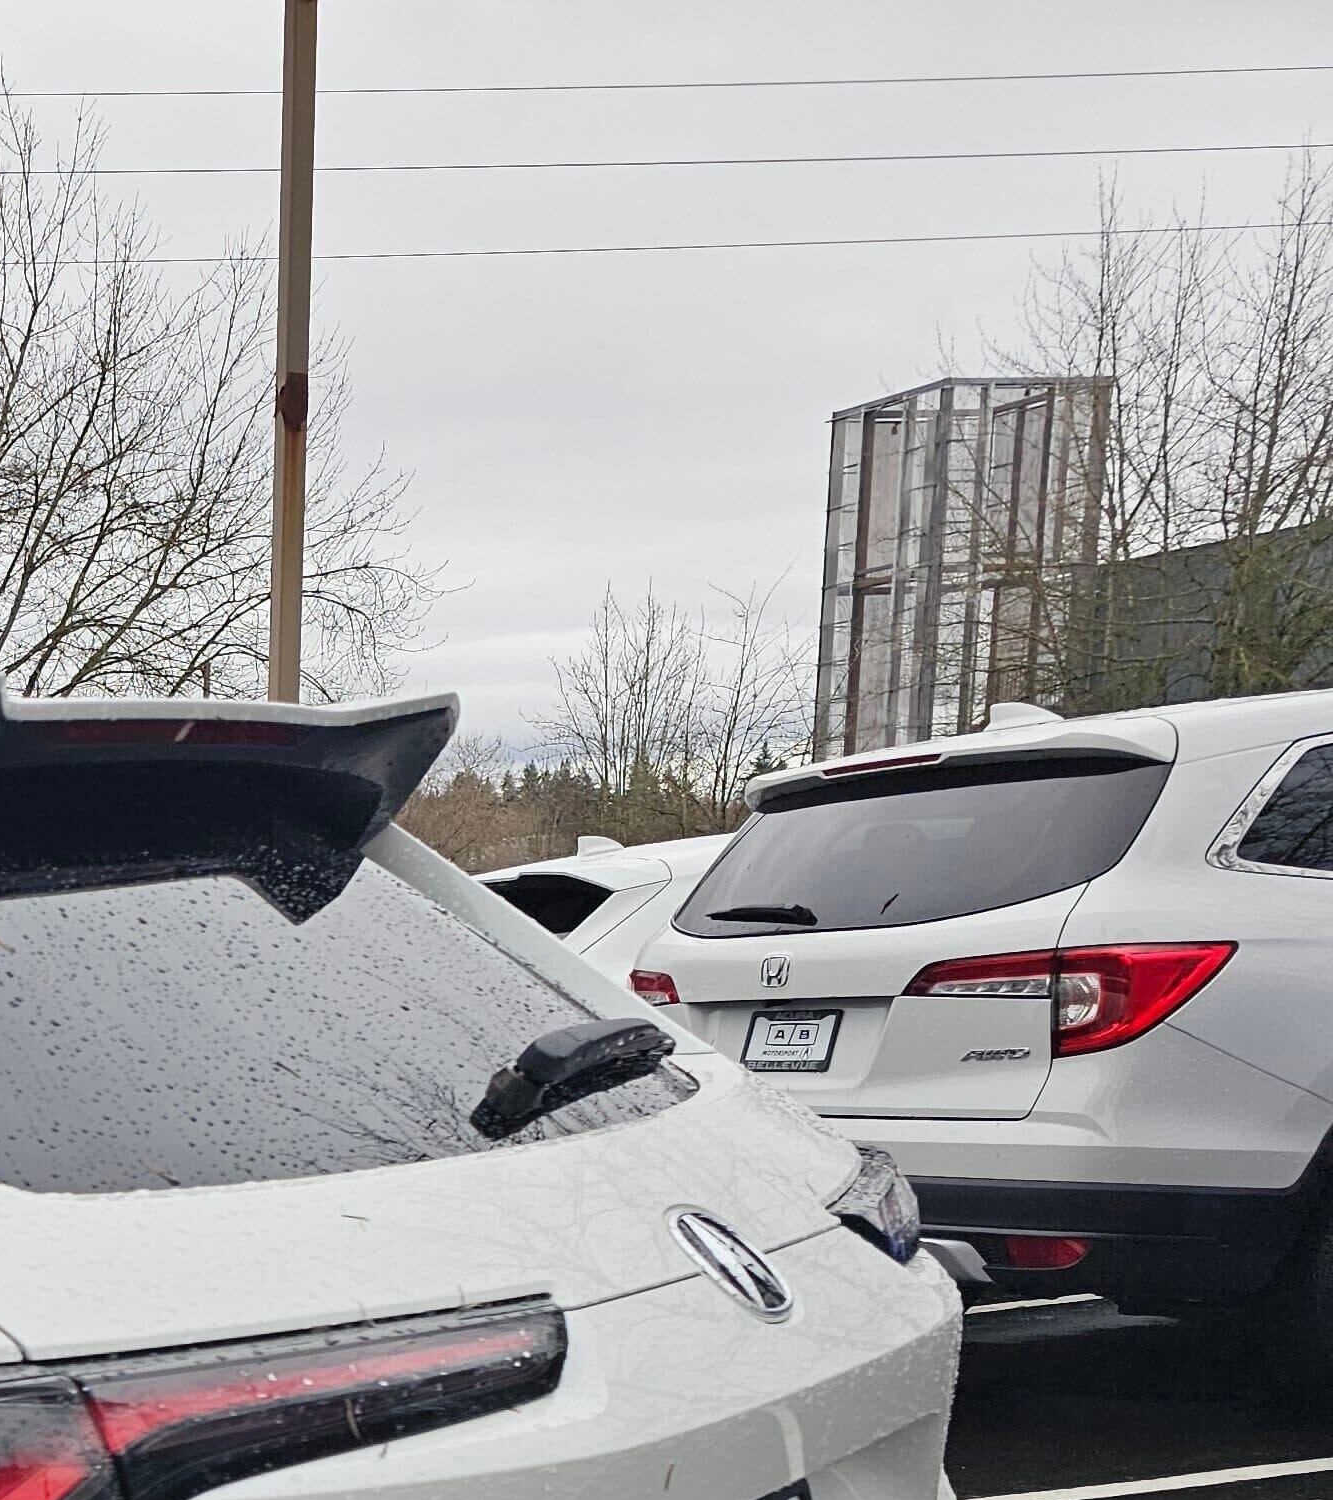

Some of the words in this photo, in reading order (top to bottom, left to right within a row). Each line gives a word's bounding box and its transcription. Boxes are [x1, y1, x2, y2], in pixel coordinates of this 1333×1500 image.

[774, 1029, 785, 1040] A
[799, 1029, 810, 1040] B
[959, 1047, 1031, 1062] AWD
[746, 1061, 820, 1070] BELLEVUE
